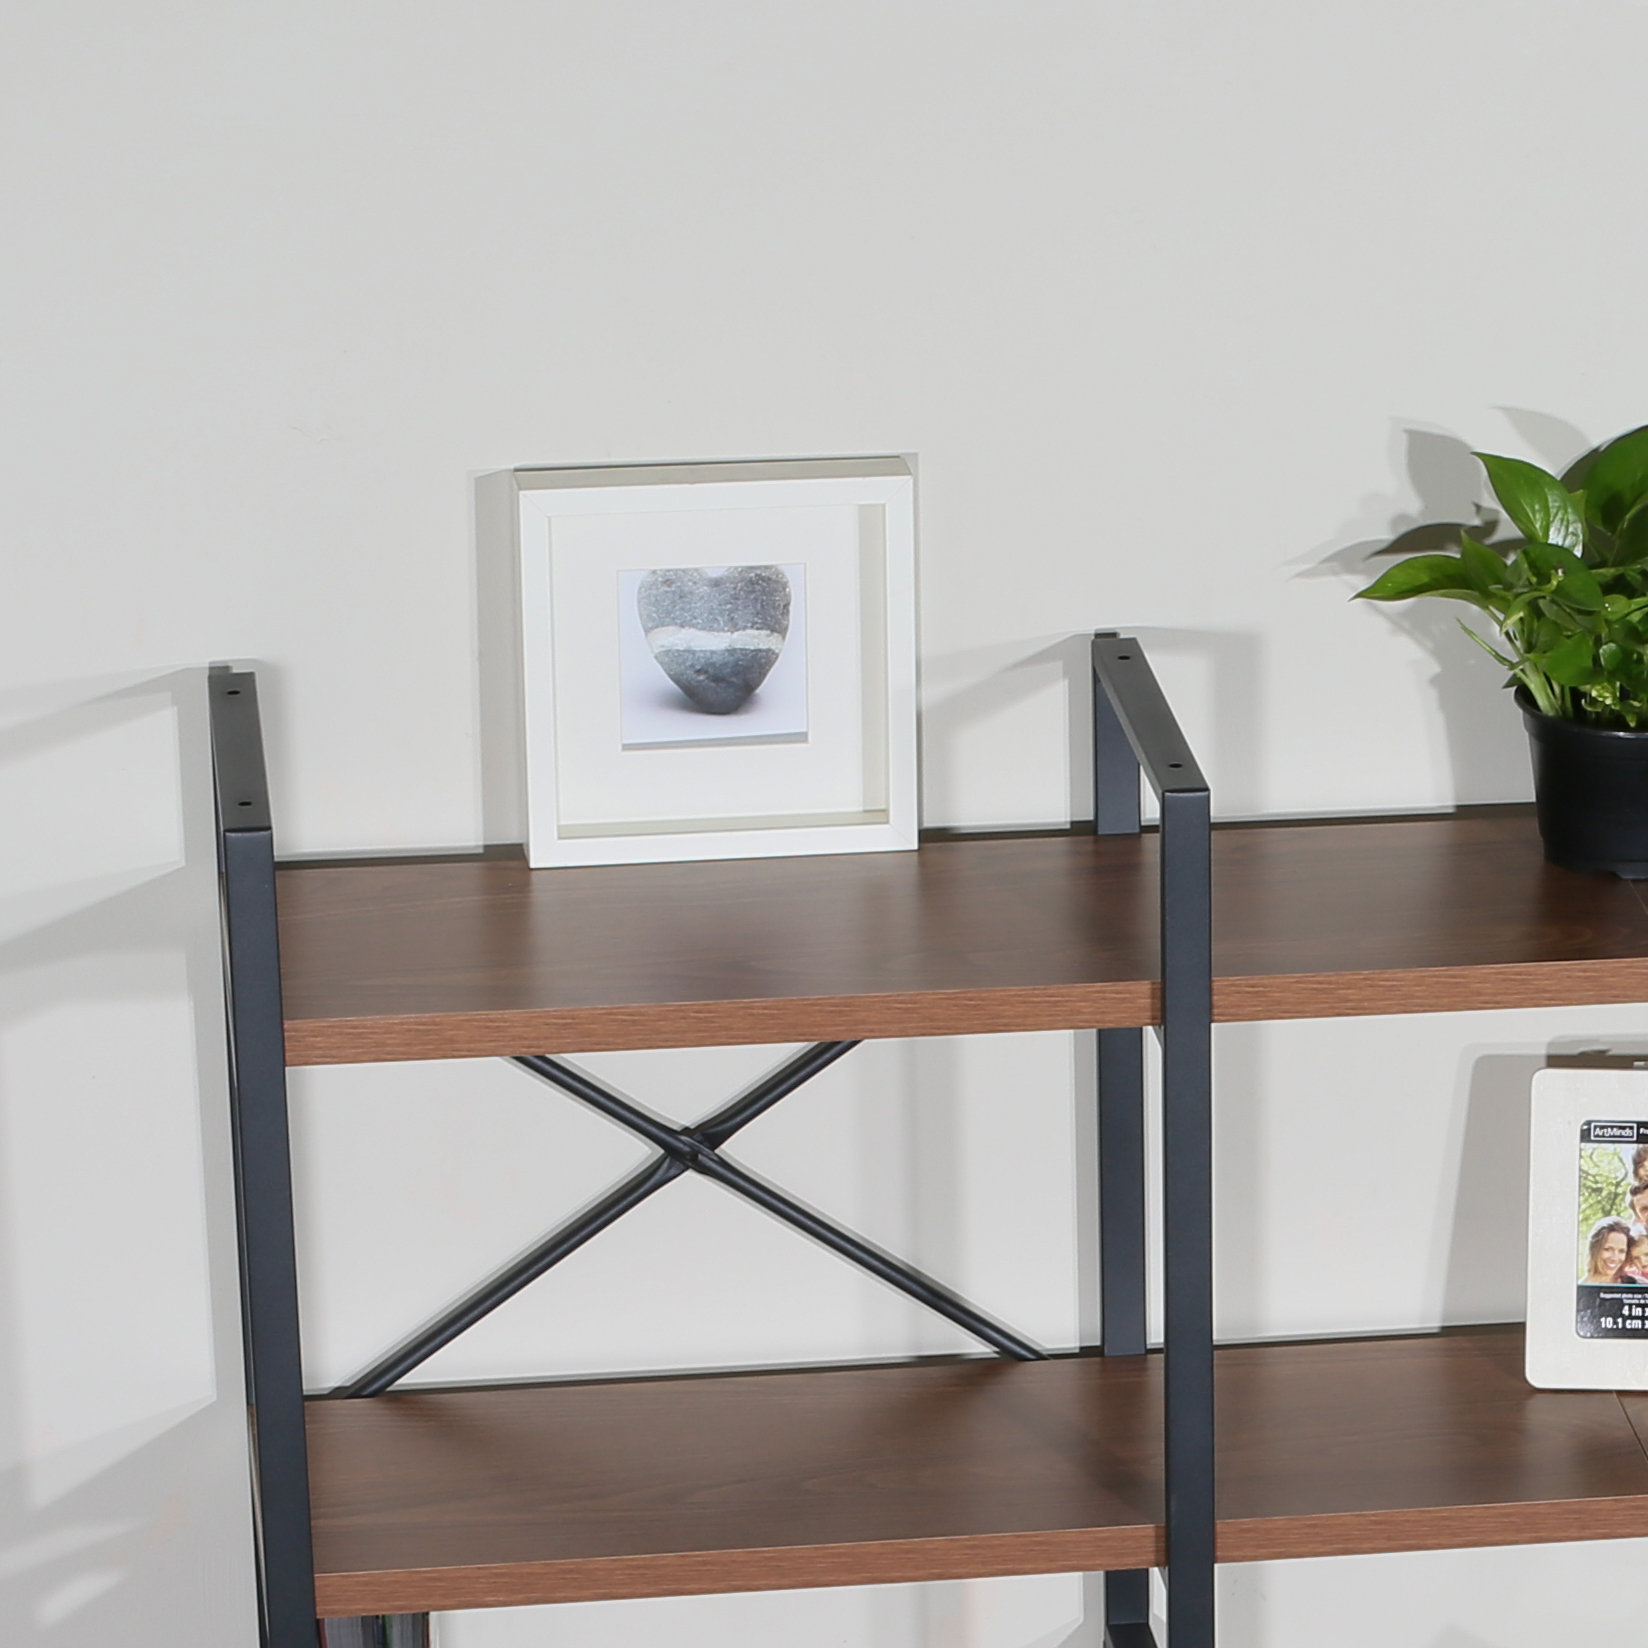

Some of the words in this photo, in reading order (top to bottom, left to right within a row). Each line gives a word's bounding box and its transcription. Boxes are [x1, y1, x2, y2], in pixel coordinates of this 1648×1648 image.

[1594, 1127, 1633, 1138] ArtMinds
[1622, 1305, 1629, 1316] 4
[1632, 1305, 1642, 1316] in
[1600, 1317, 1622, 1329] 10.1
[1625, 1320, 1642, 1329] cm
